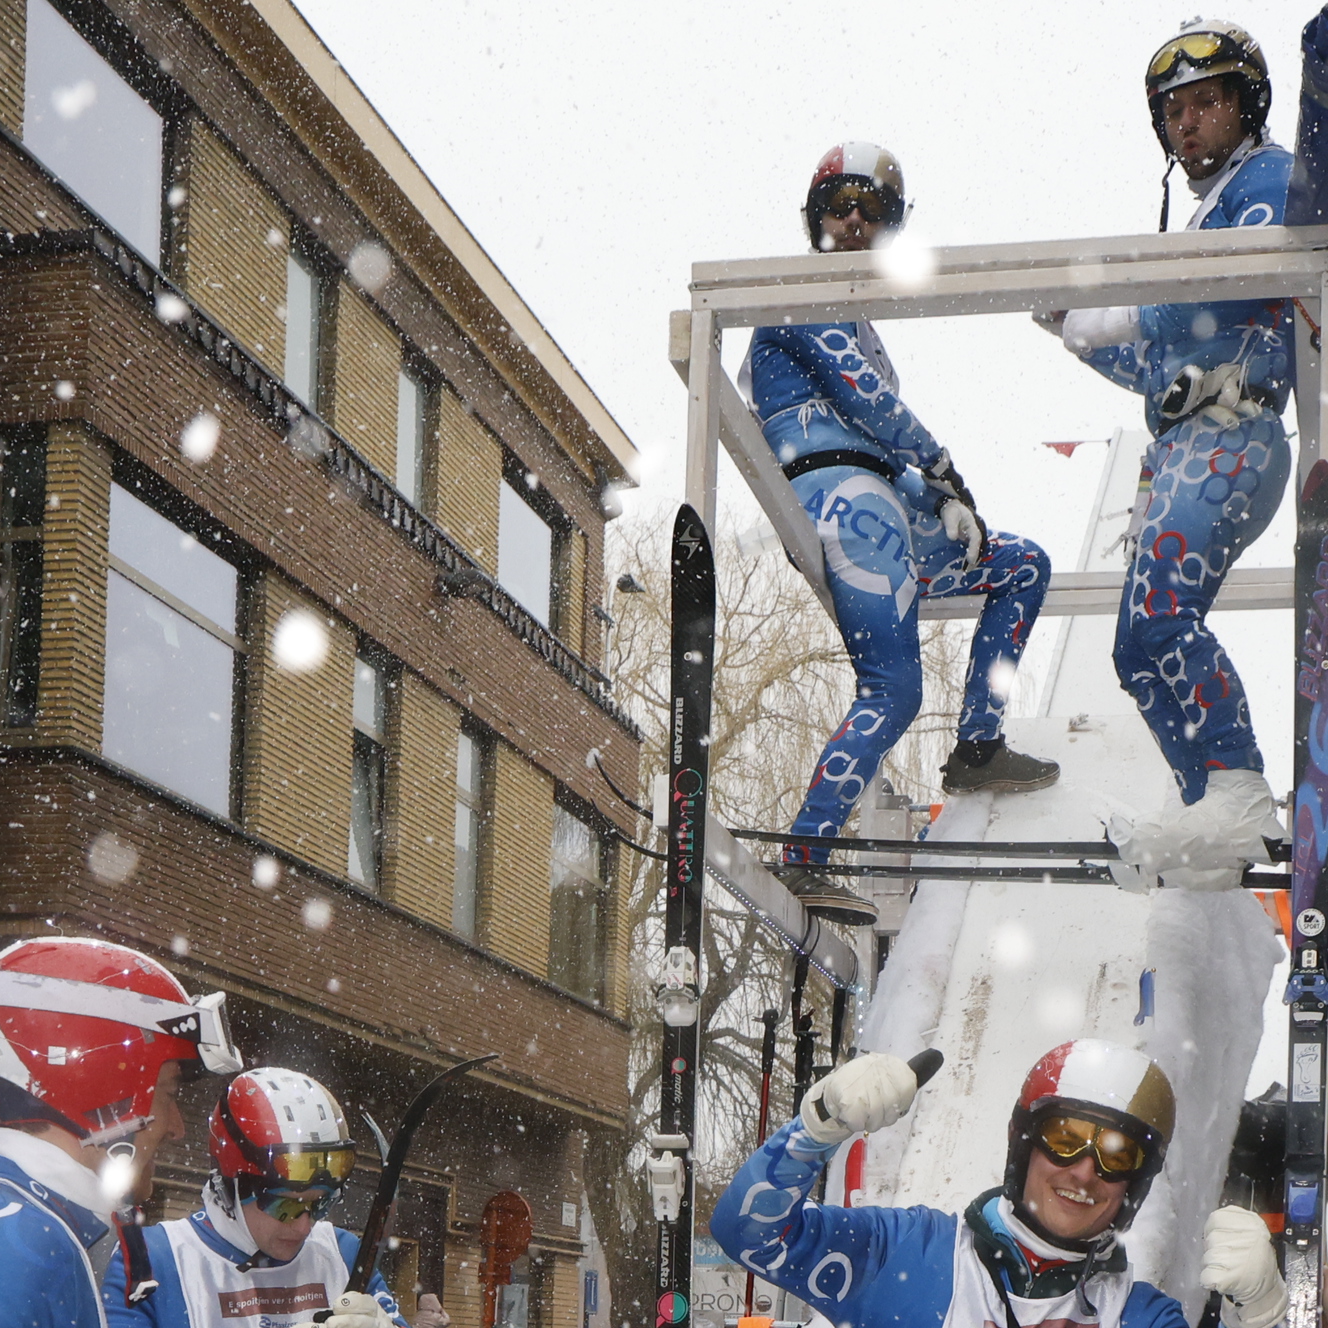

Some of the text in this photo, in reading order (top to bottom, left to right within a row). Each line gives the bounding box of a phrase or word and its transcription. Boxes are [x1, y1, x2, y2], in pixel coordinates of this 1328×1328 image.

[803, 488, 919, 580] ARCTI
[674, 697, 683, 765] BLIZZARD
[659, 1224, 670, 1289] LIZZARD
[228, 1300, 234, 1308] E
